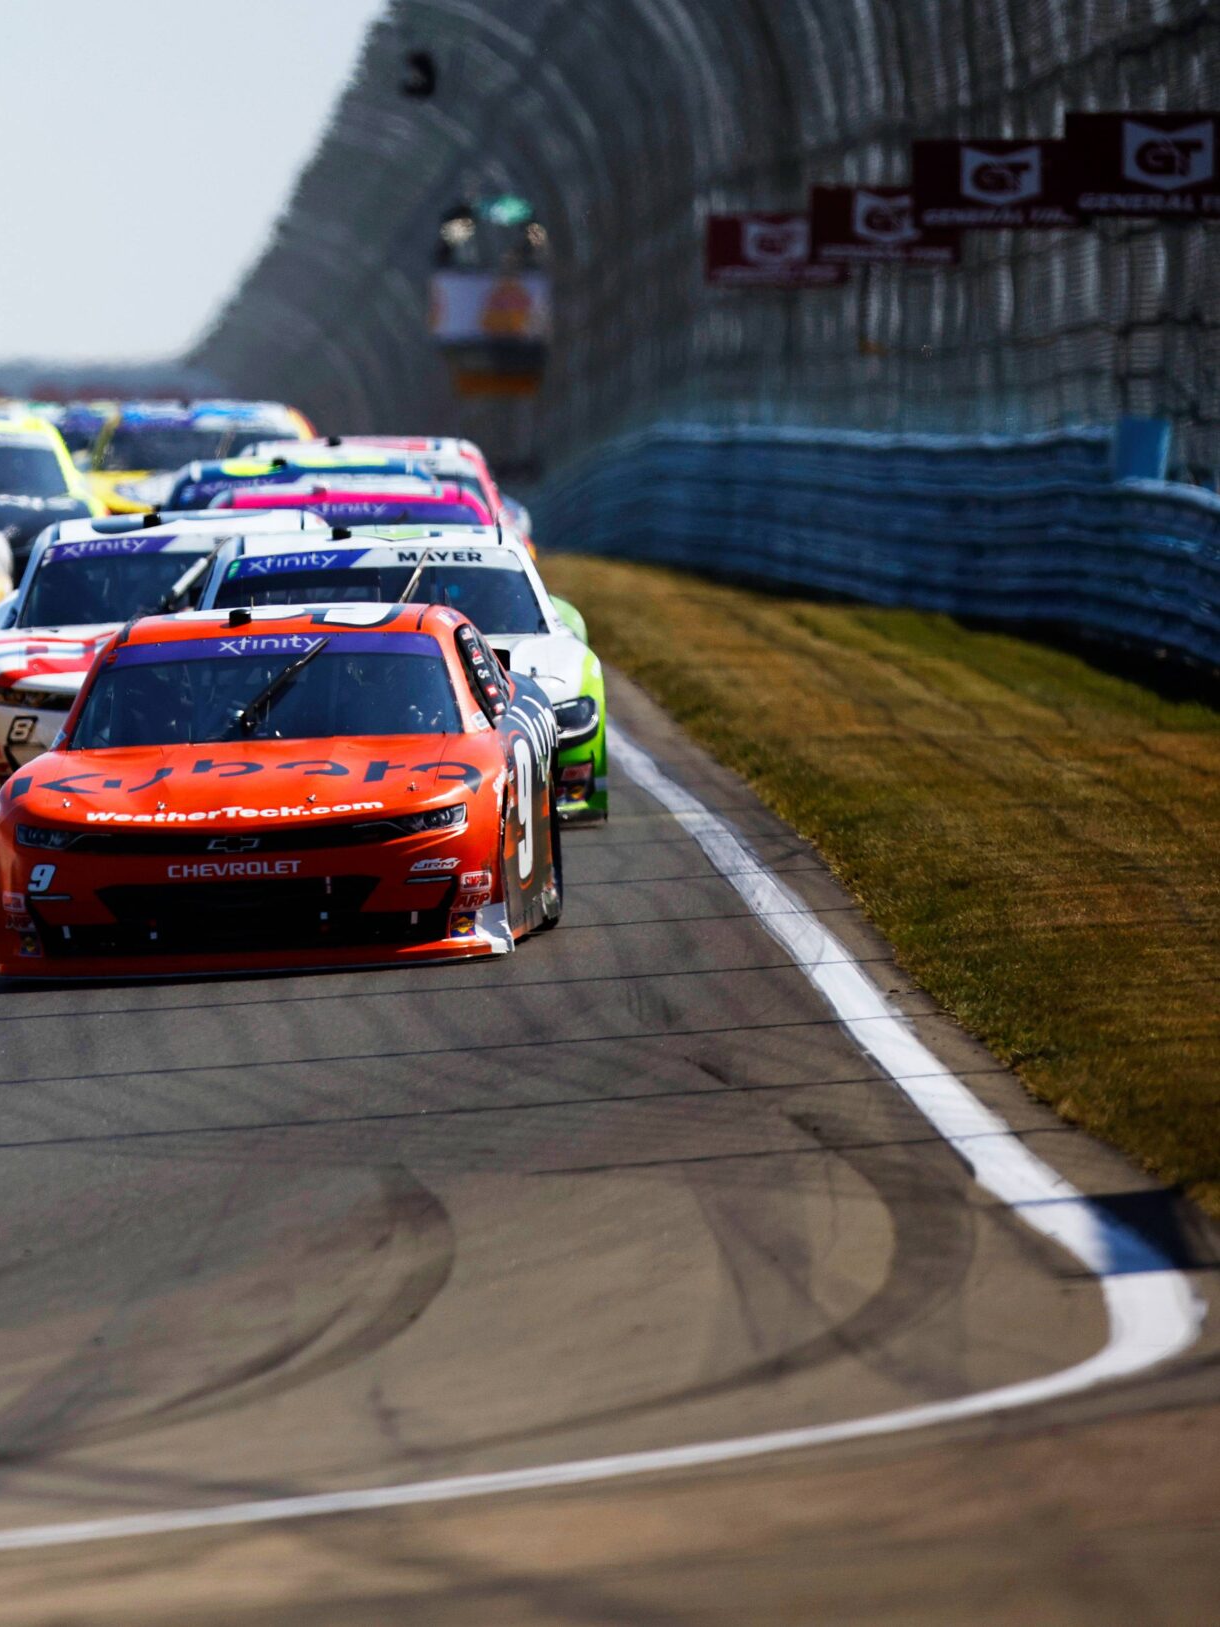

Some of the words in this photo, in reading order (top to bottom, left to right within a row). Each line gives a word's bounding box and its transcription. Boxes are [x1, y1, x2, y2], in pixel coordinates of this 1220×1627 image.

[1077, 191, 1196, 212] GENERAL
[61, 537, 148, 558] xfinity
[248, 551, 338, 573] xfinity
[398, 551, 483, 562] MAYER
[218, 634, 325, 656] xfinity
[8, 715, 38, 745] 8
[86, 799, 384, 823] WeatherTech.com
[514, 738, 533, 880] 9
[167, 859, 302, 879] CHEVROLET
[412, 859, 458, 871] JRM
[28, 864, 56, 892] 9
